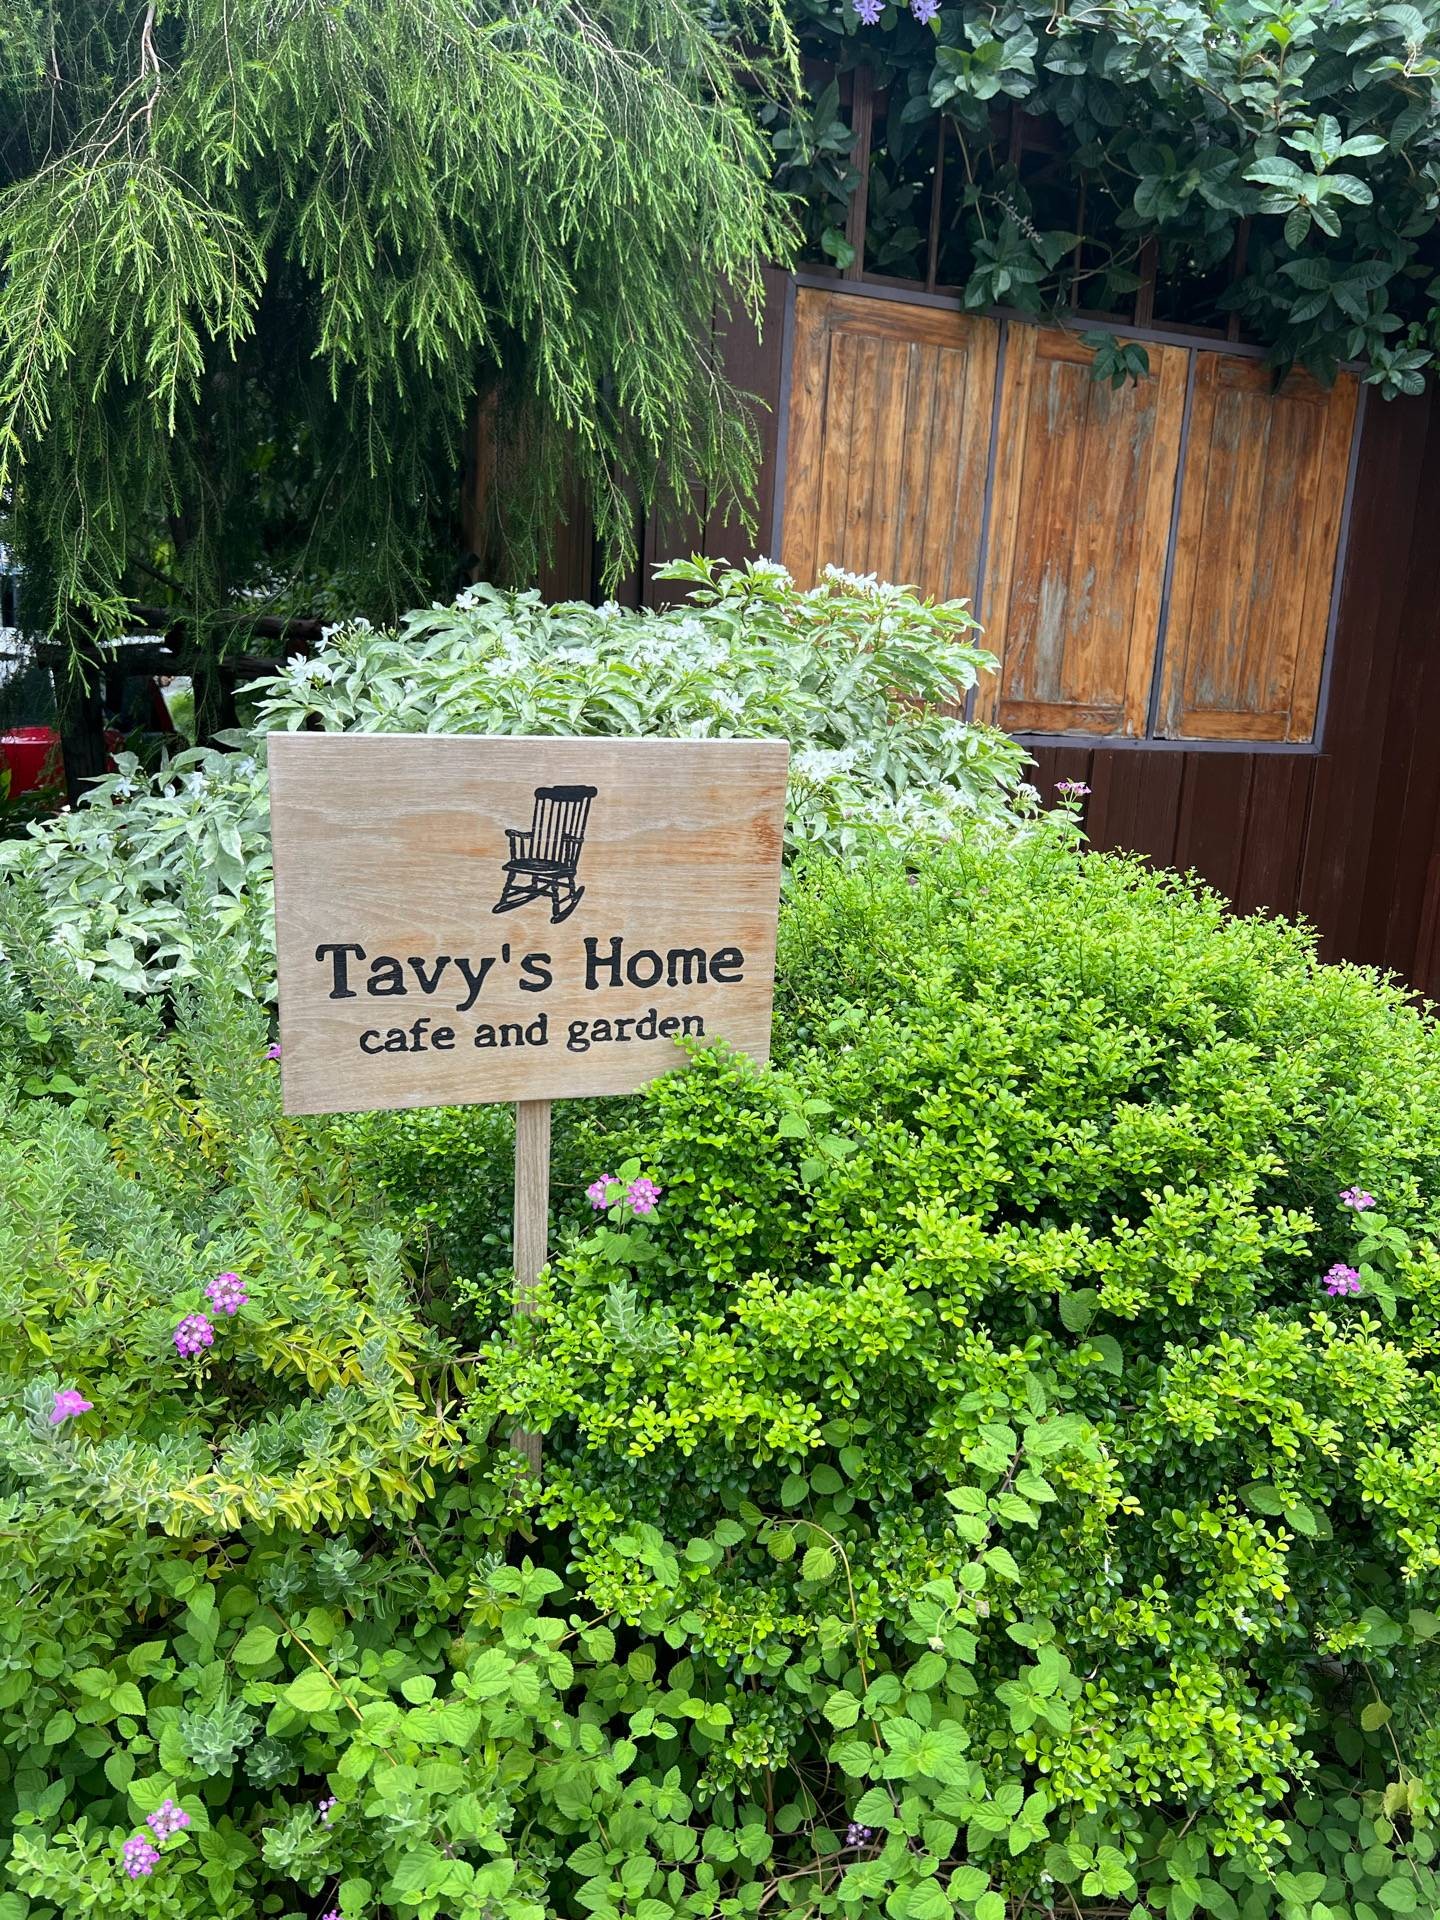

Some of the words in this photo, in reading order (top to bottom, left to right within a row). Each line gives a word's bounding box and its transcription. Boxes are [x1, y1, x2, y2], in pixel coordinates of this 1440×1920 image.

[315, 943, 553, 1012] Tavy's
[583, 936, 745, 990] Home
[359, 1017, 455, 1055] cafe
[474, 1012, 548, 1048] and
[566, 1008, 705, 1053] garden
